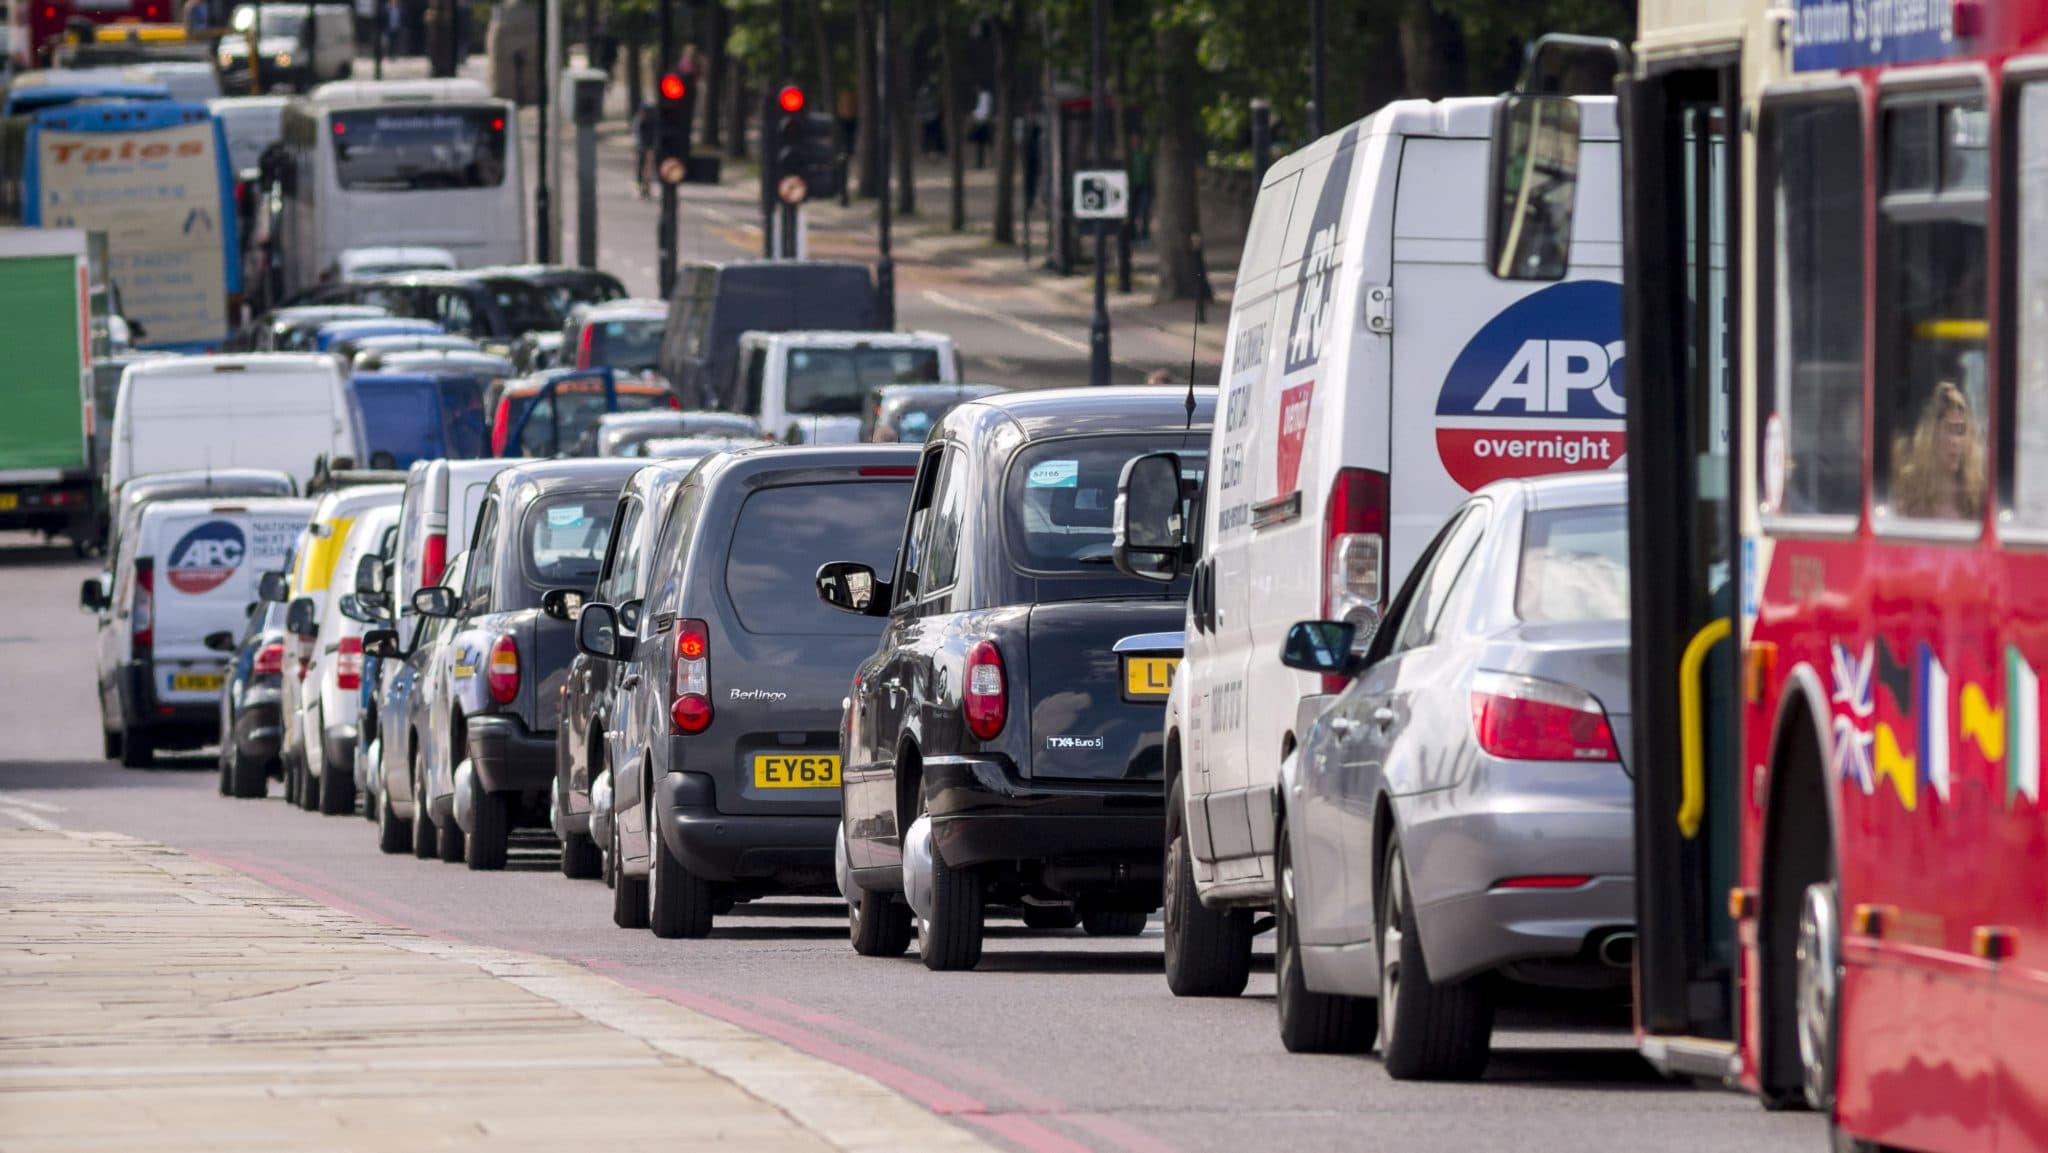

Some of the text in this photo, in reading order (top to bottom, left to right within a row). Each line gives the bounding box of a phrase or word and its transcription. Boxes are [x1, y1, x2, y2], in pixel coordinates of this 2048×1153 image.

[1793, 0, 1849, 46] London
[49, 141, 204, 165] Tates
[1473, 436, 1611, 465] overnight
[176, 539, 243, 568] APC
[730, 688, 787, 702] Berlingo
[1049, 737, 1074, 748] TX4
[1075, 739, 1094, 748] Euro
[765, 758, 833, 782] EY63
